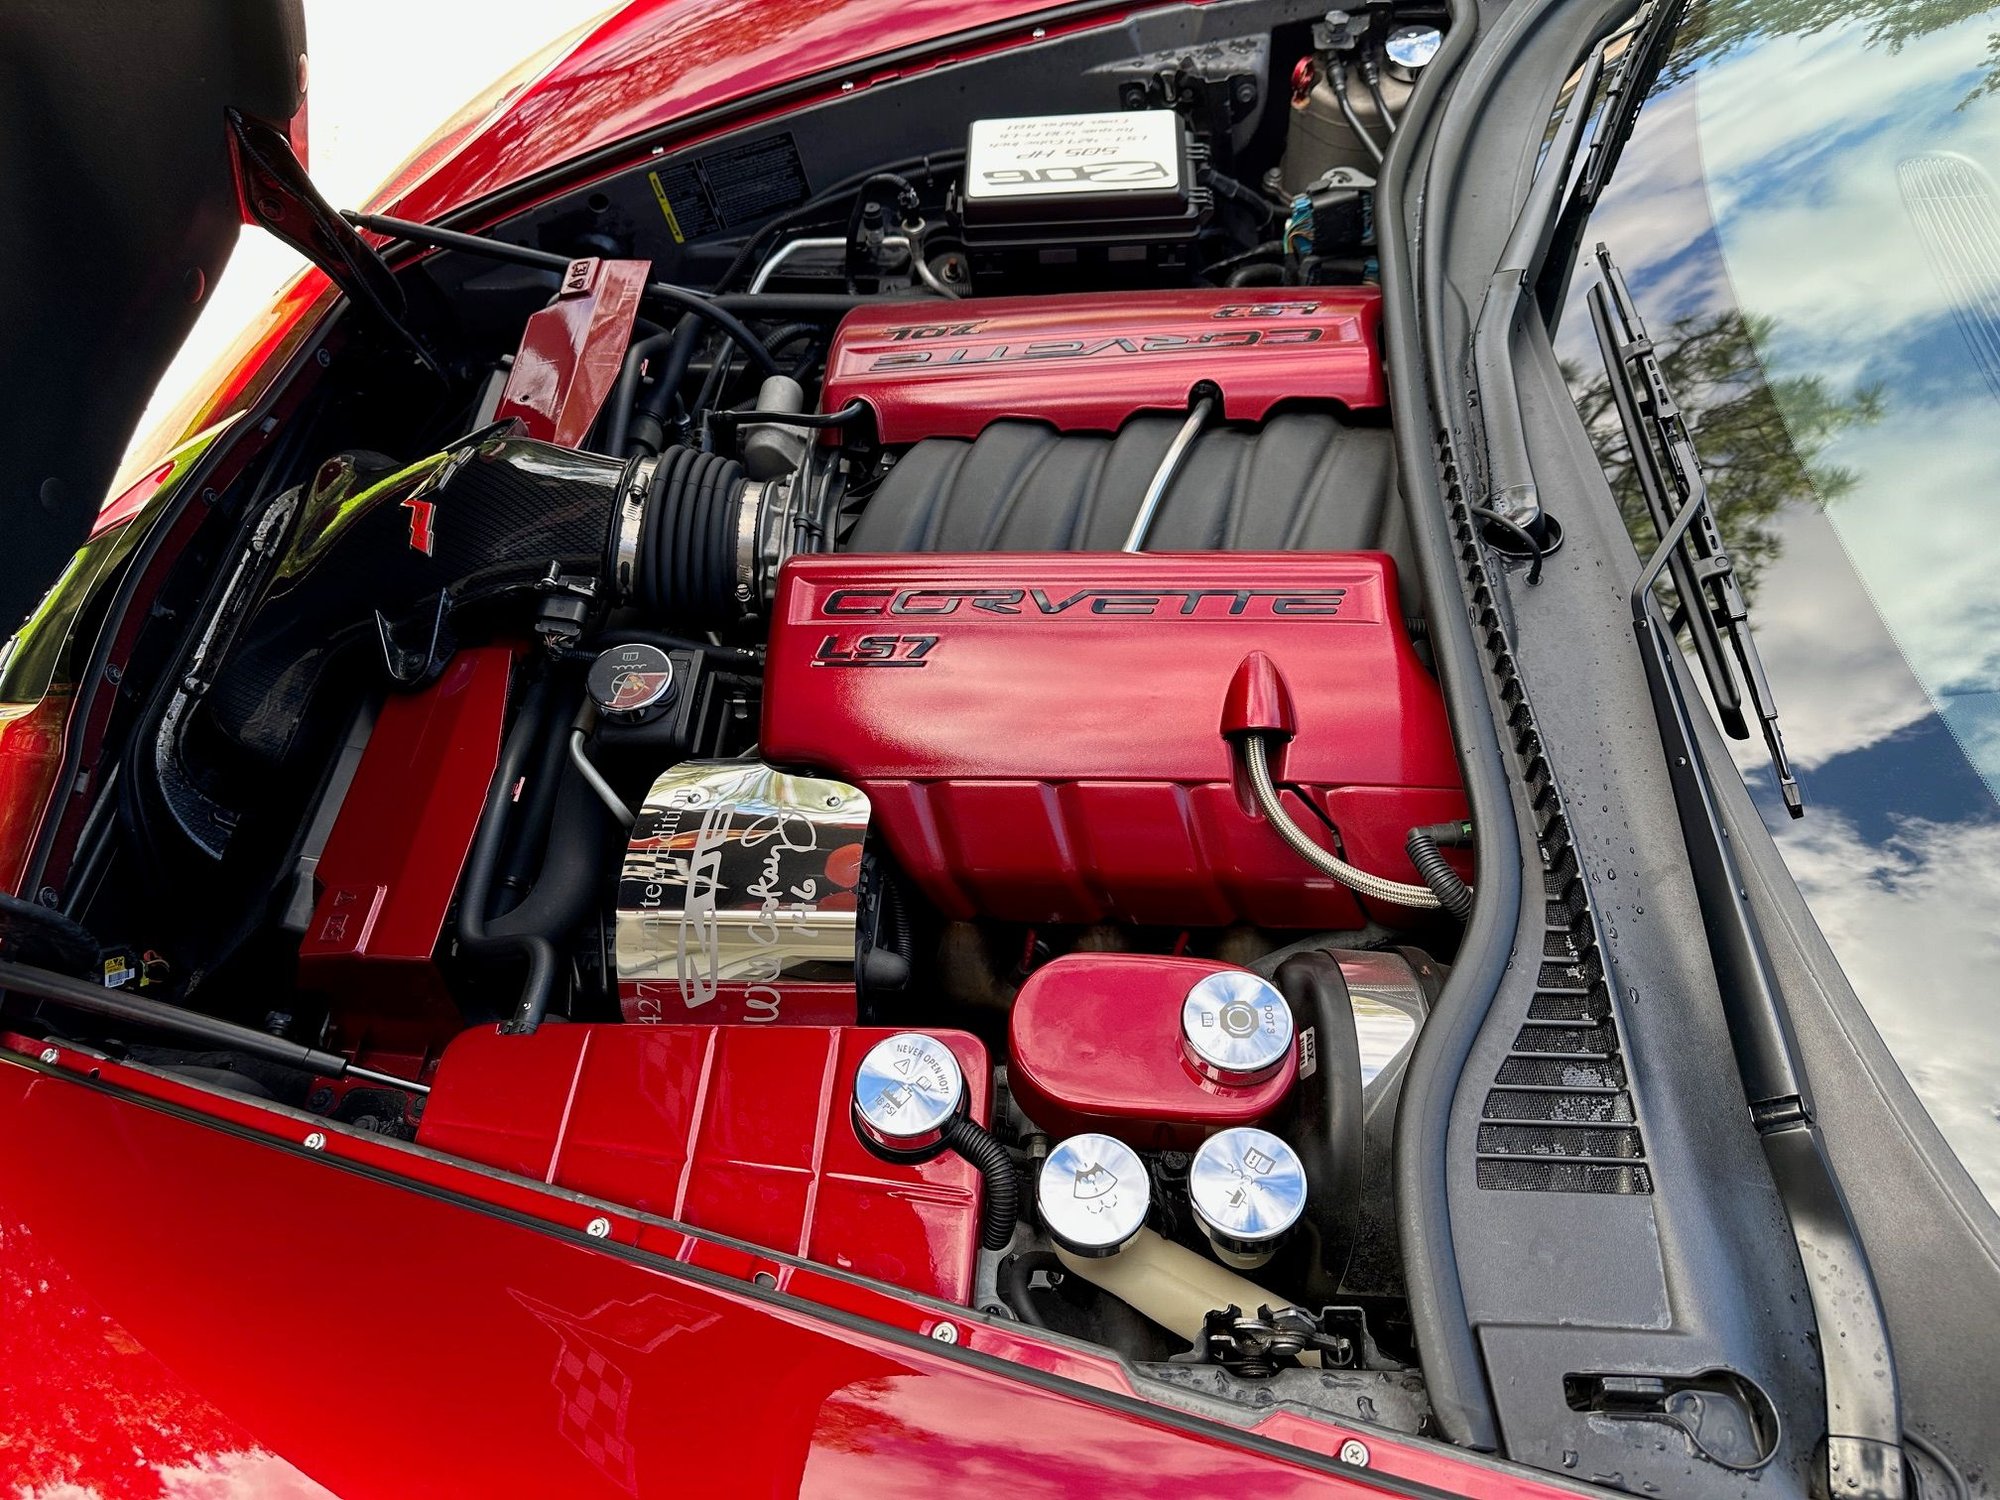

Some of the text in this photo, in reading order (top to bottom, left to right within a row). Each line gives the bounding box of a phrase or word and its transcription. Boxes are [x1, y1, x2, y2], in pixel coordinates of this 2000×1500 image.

[1015, 147, 1120, 160] 505 HP
[982, 160, 1170, 186] Z06
[1212, 302, 1322, 318] LS7
[869, 328, 1326, 371] CORVETTE
[821, 588, 1347, 616] CORVETTE
[814, 634, 942, 662] LS7
[634, 788, 691, 1025] 427 Limited Edition
[677, 804, 736, 1009] Z06
[1263, 1004, 1275, 1027] DOT
[1306, 1033, 1315, 1062] ADX
[896, 1044, 950, 1095] NEVER OPEN HOT!
[882, 1102, 897, 1117] PSI
